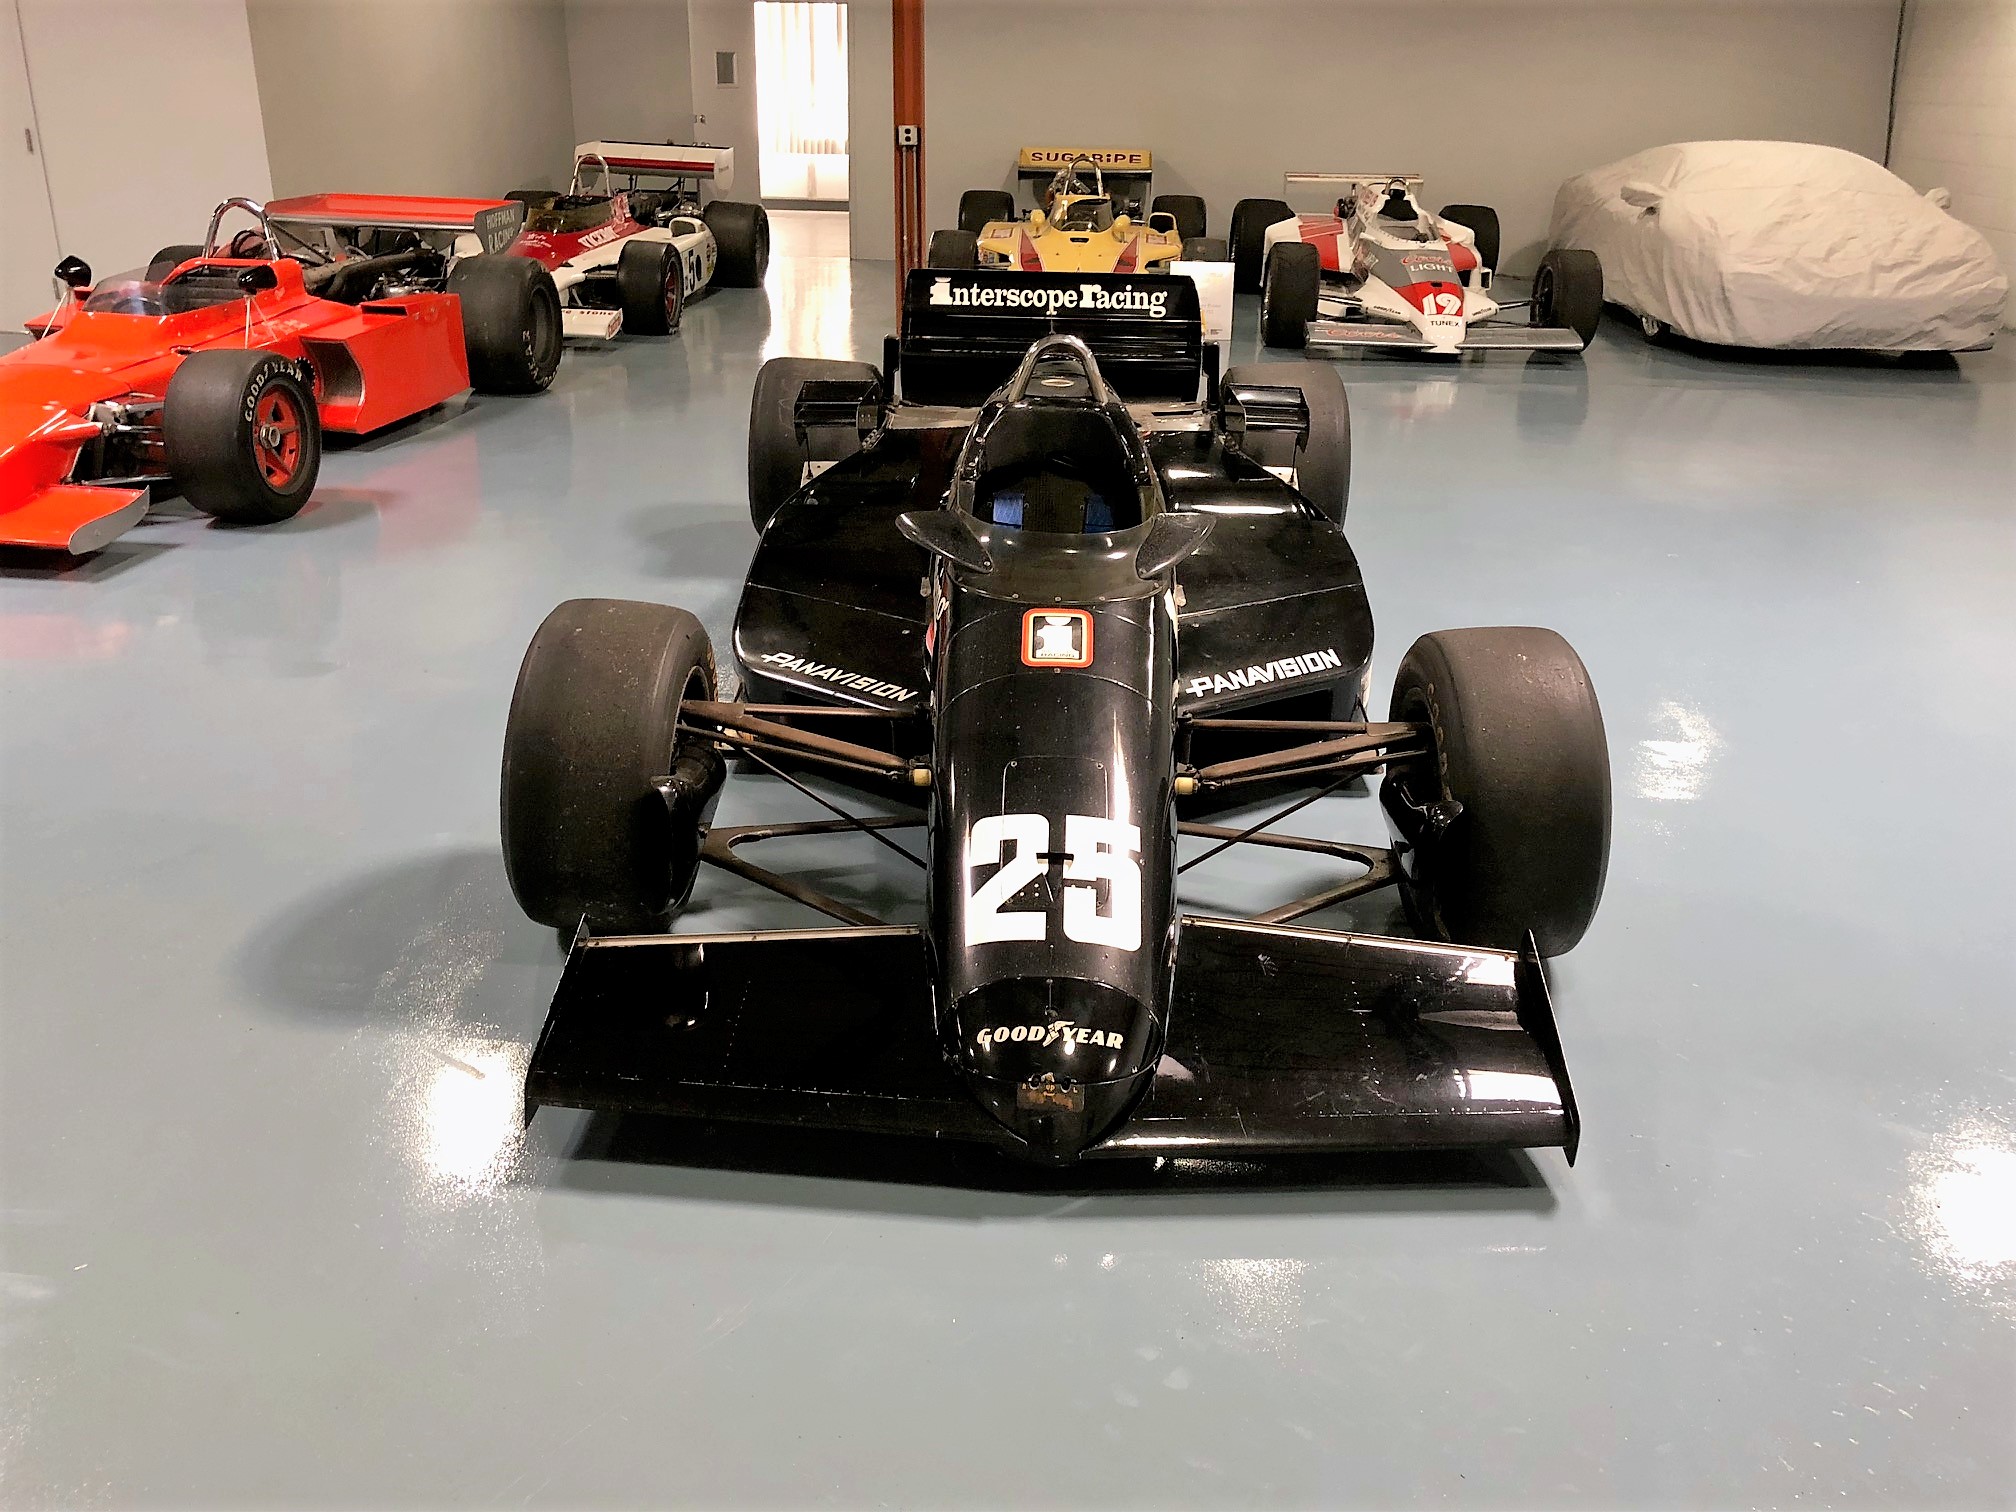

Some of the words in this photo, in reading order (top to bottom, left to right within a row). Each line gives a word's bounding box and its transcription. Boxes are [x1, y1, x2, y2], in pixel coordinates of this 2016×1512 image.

[1409, 263, 1455, 273] LIGHT
[1422, 292, 1462, 315] 19
[1430, 320, 1461, 328] TUNEX
[760, 651, 919, 702] PANAVISION
[1185, 648, 1342, 698] PANAVISION
[964, 812, 1142, 952] 25
